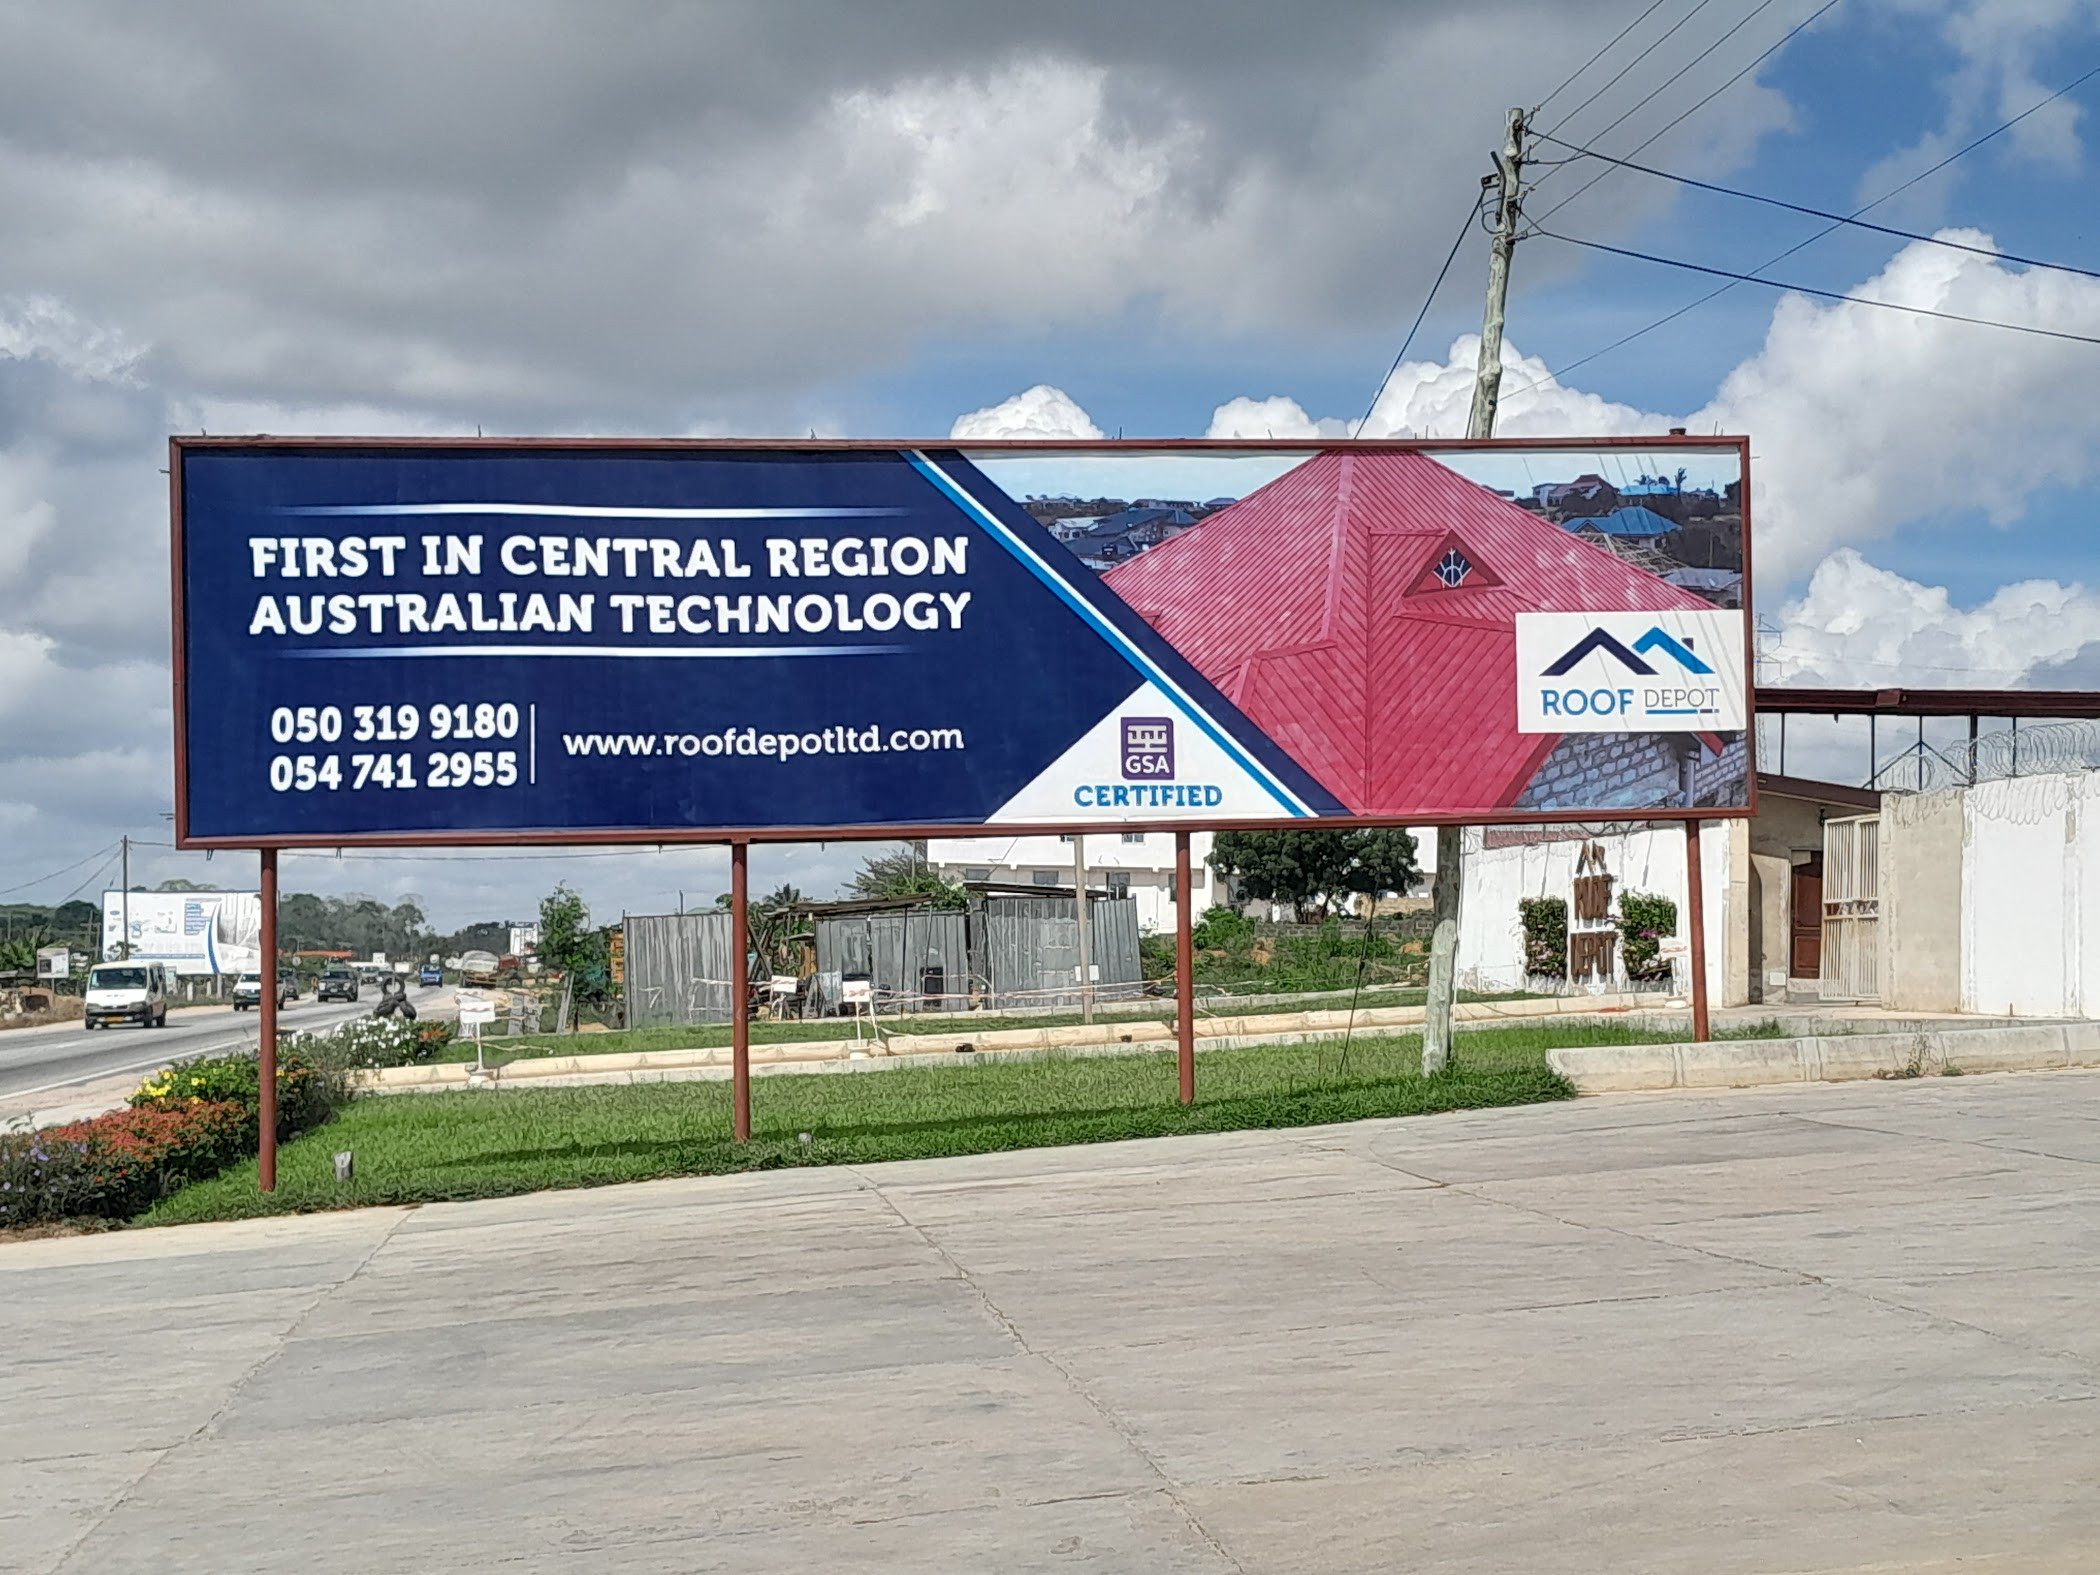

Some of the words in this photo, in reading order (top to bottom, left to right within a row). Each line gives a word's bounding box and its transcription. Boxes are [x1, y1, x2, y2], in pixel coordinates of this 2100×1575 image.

[250, 537, 406, 577] FIRST
[422, 535, 483, 575] IN
[500, 535, 751, 577] CENTRAL
[766, 536, 969, 577] REGION
[249, 593, 595, 635] AUSTRALIAN
[610, 591, 971, 634] TECHNOLOGY
[1540, 688, 1634, 716] ROOF
[1644, 688, 1720, 708] DEPOT
[271, 706, 342, 743] 050
[353, 704, 420, 741] 319
[429, 703, 519, 740] 9180
[562, 725, 965, 762] www.roofdepotltd.com
[270, 755, 343, 792] 054
[352, 753, 417, 790] 741
[427, 751, 518, 787] 2955
[1125, 755, 1170, 774] GSA
[1073, 784, 1223, 807] CERTIFIED
